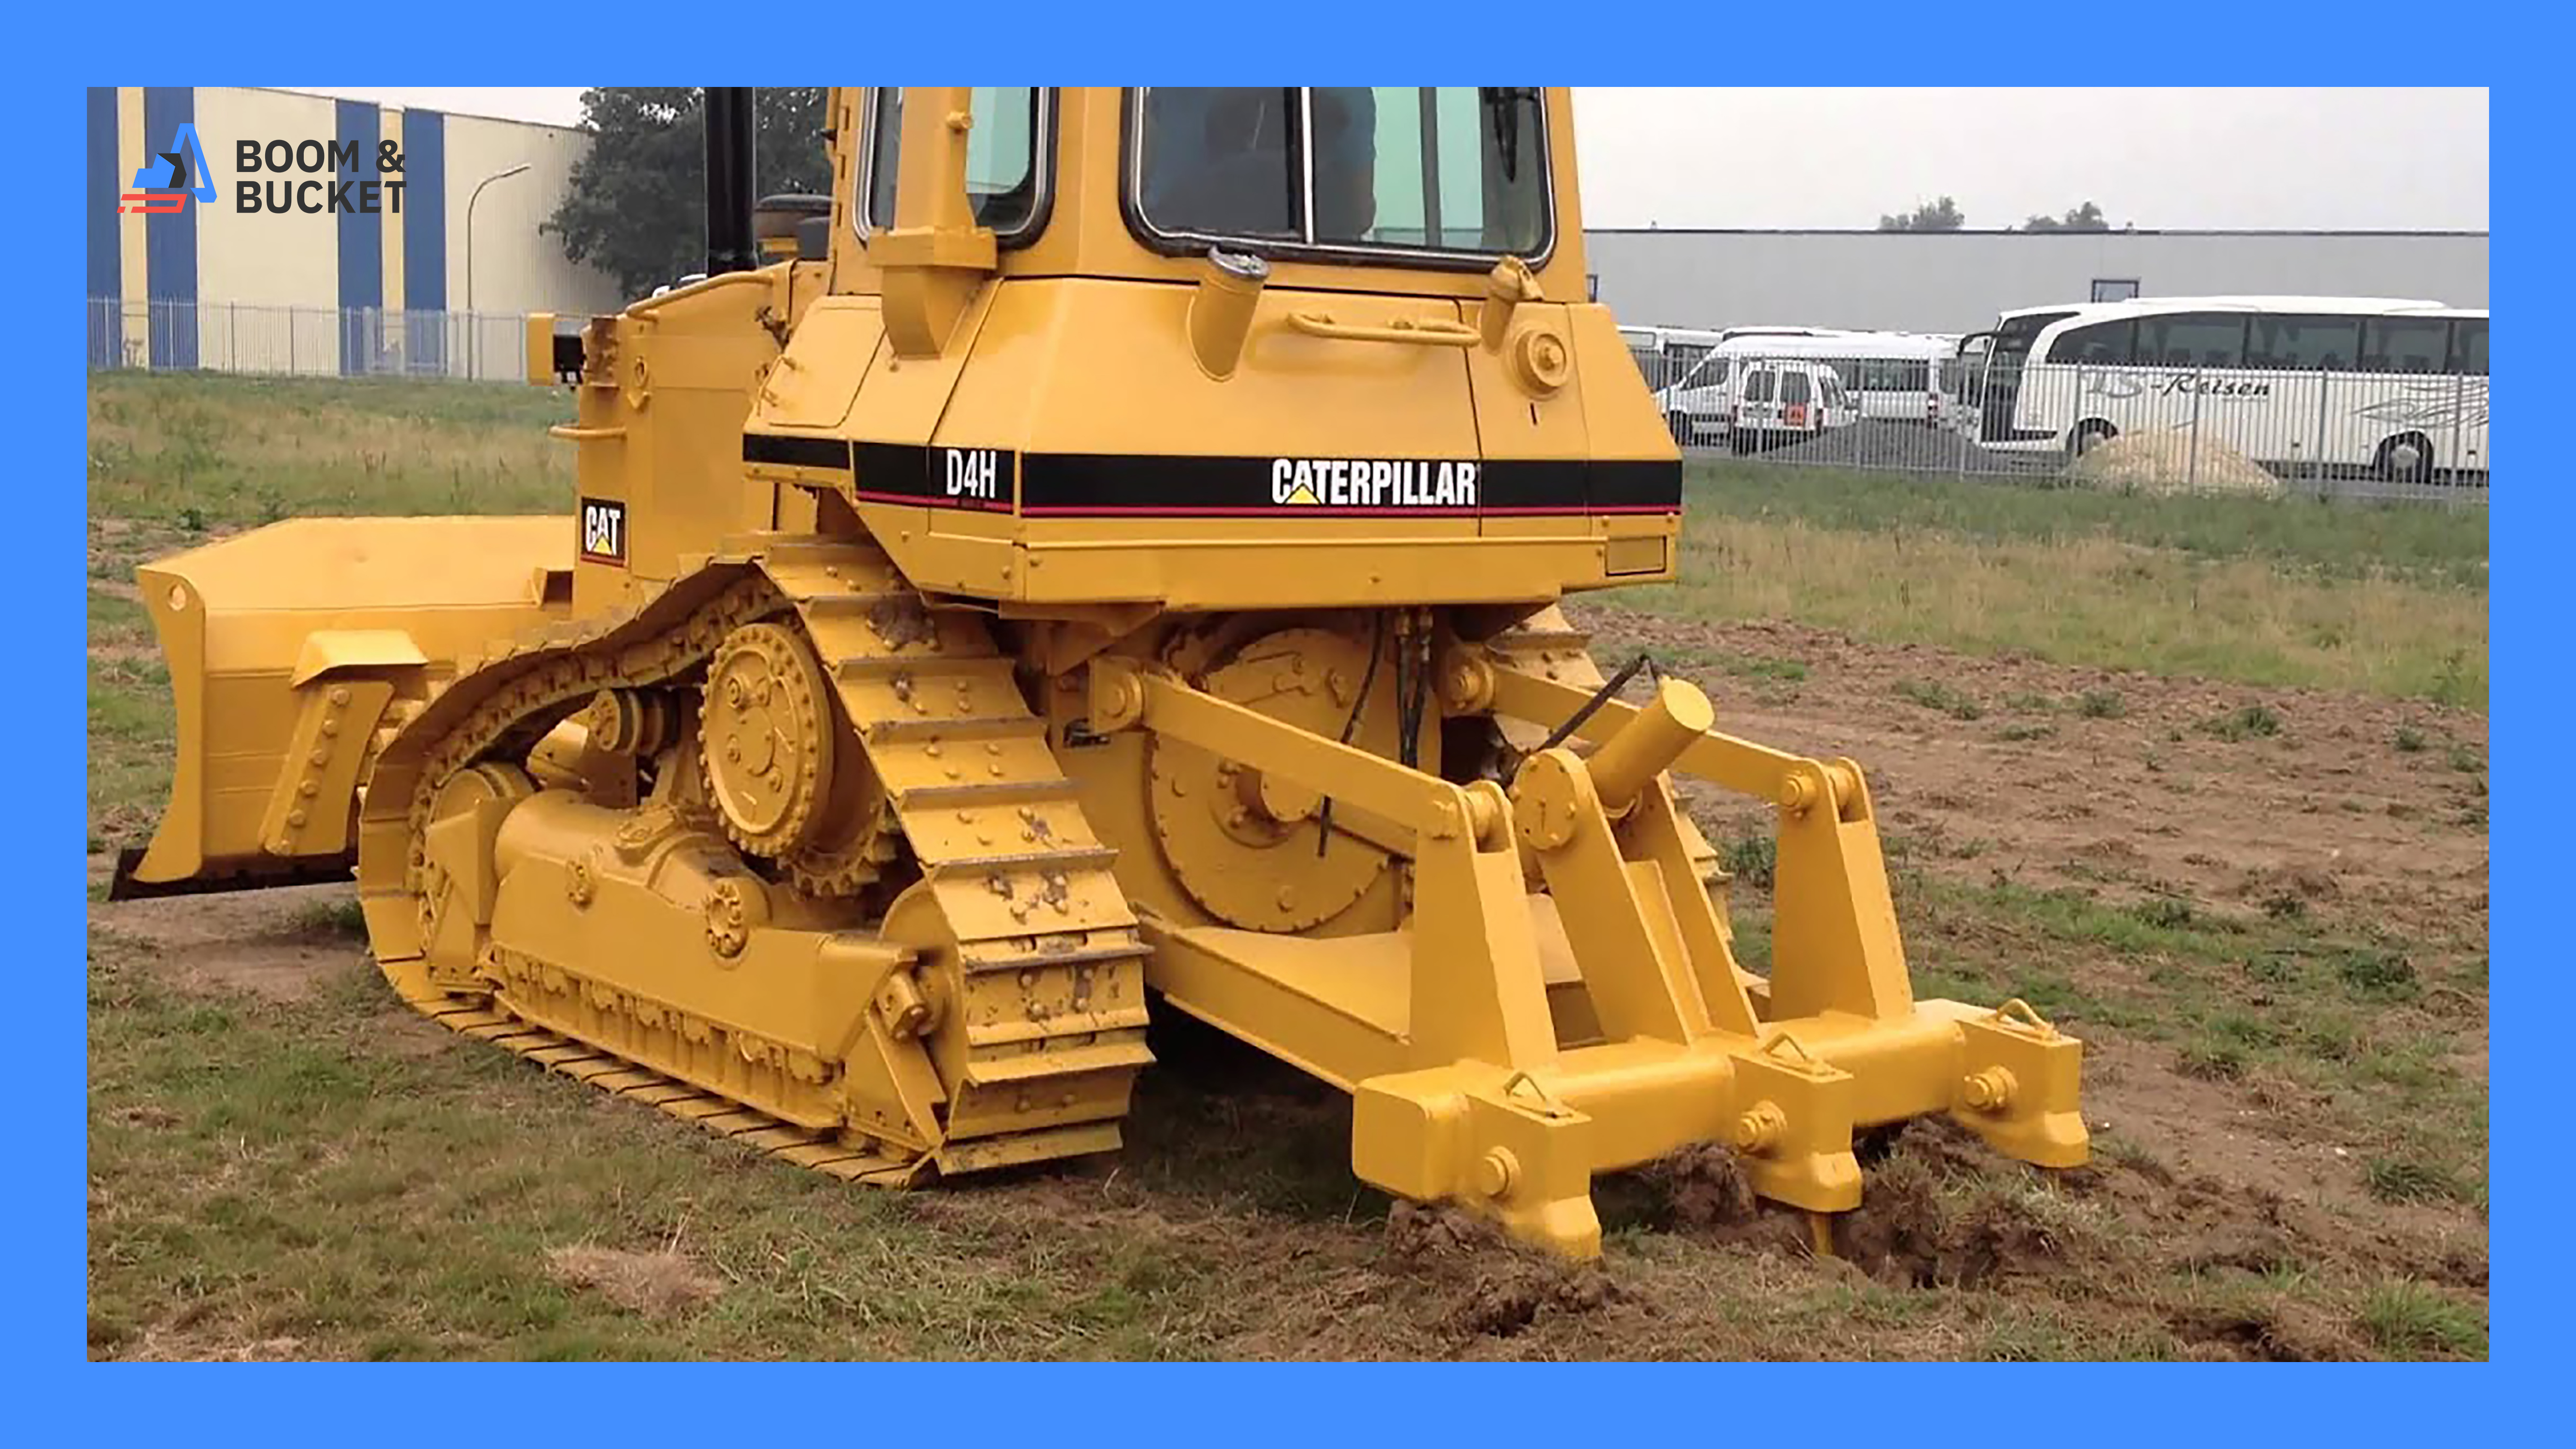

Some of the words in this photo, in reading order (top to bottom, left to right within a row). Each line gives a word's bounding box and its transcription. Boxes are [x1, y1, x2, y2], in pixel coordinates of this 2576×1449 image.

[947, 449, 996, 498] D4H
[1272, 459, 1475, 505] CATERPILLAR
[585, 506, 621, 555] CAT
